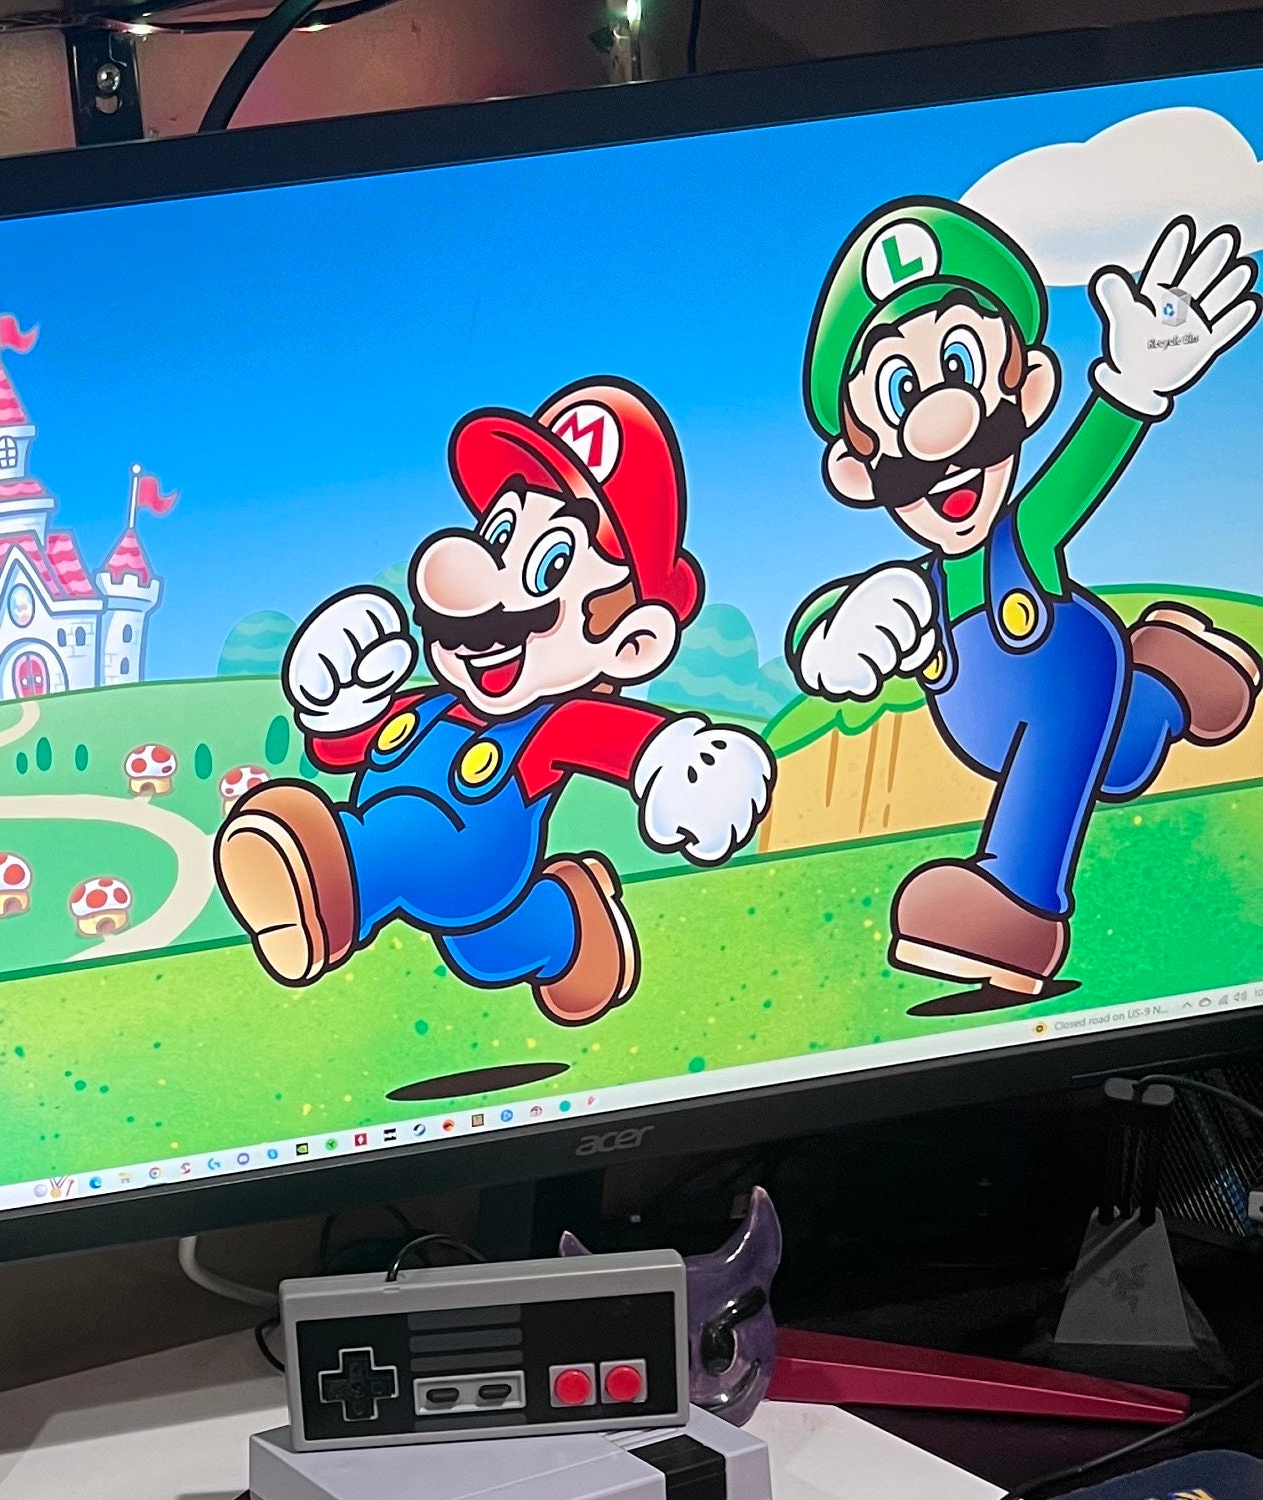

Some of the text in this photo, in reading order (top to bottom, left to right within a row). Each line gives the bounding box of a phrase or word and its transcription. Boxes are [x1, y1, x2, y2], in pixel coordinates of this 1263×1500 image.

[882, 235, 924, 284] L
[557, 411, 604, 467] M
[1054, 1017, 1086, 1031] Closed
[1088, 1013, 1110, 1025] road
[1112, 1013, 1126, 1022] on
[1127, 1006, 1151, 1019] US-9
[575, 1125, 655, 1156] acer
